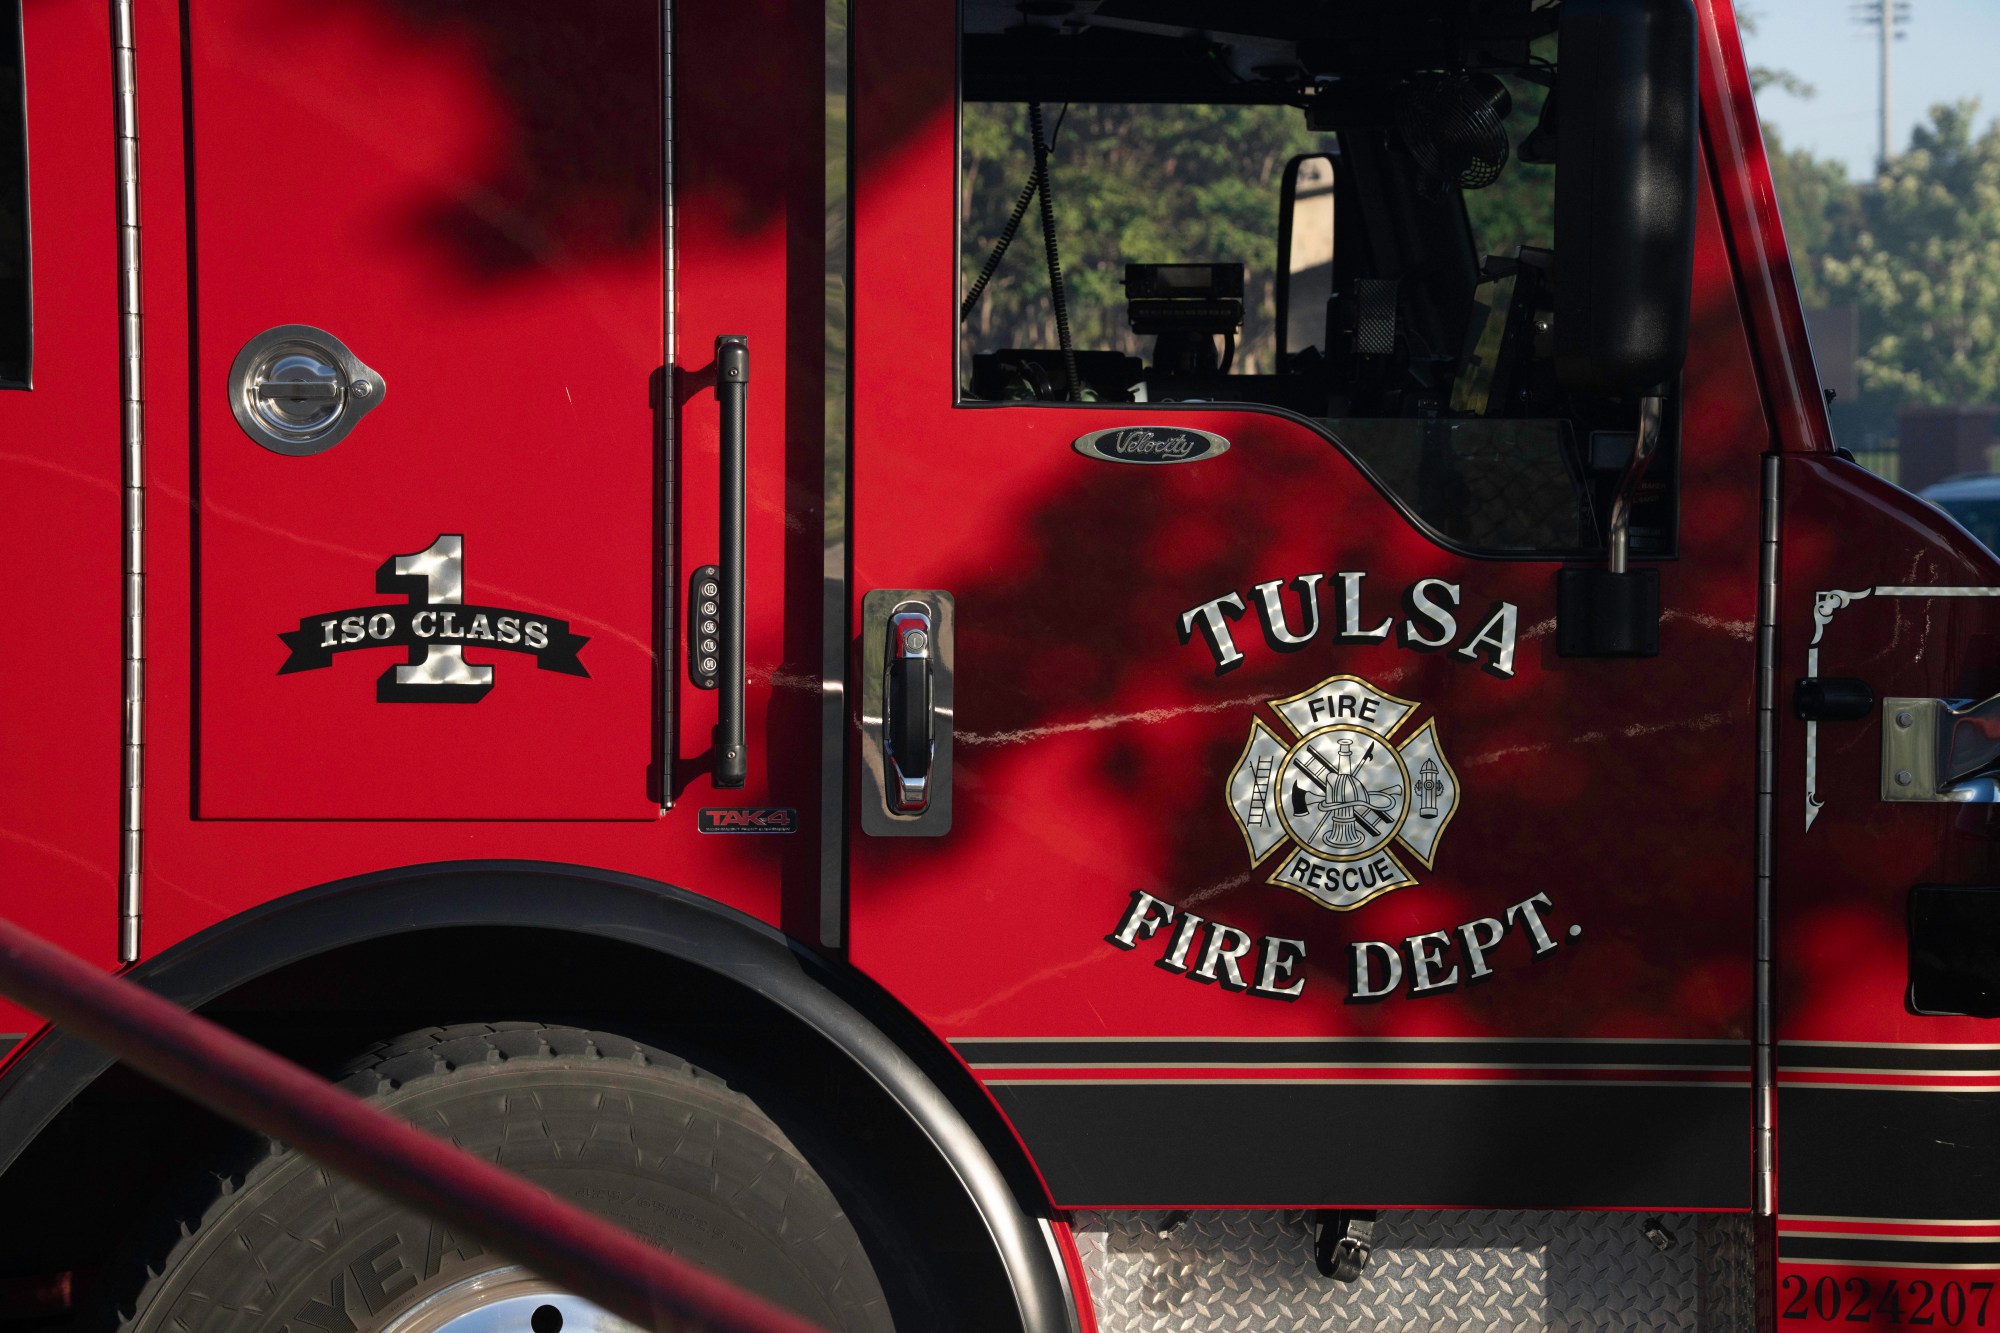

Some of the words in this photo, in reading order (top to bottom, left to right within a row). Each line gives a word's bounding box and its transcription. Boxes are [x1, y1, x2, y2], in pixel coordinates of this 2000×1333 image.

[1115, 431, 1195, 459] Velocity
[320, 612, 396, 648] ISO
[411, 611, 549, 649] CLASS
[380, 534, 494, 700] 1
[1178, 571, 1518, 678] TULSA
[1308, 694, 1380, 723] FIRE
[1290, 856, 1394, 892] RESCUE
[1108, 890, 1307, 999] FIRE
[1347, 891, 1582, 1000] DEPT.
[1781, 1274, 1995, 1327] 2024207
